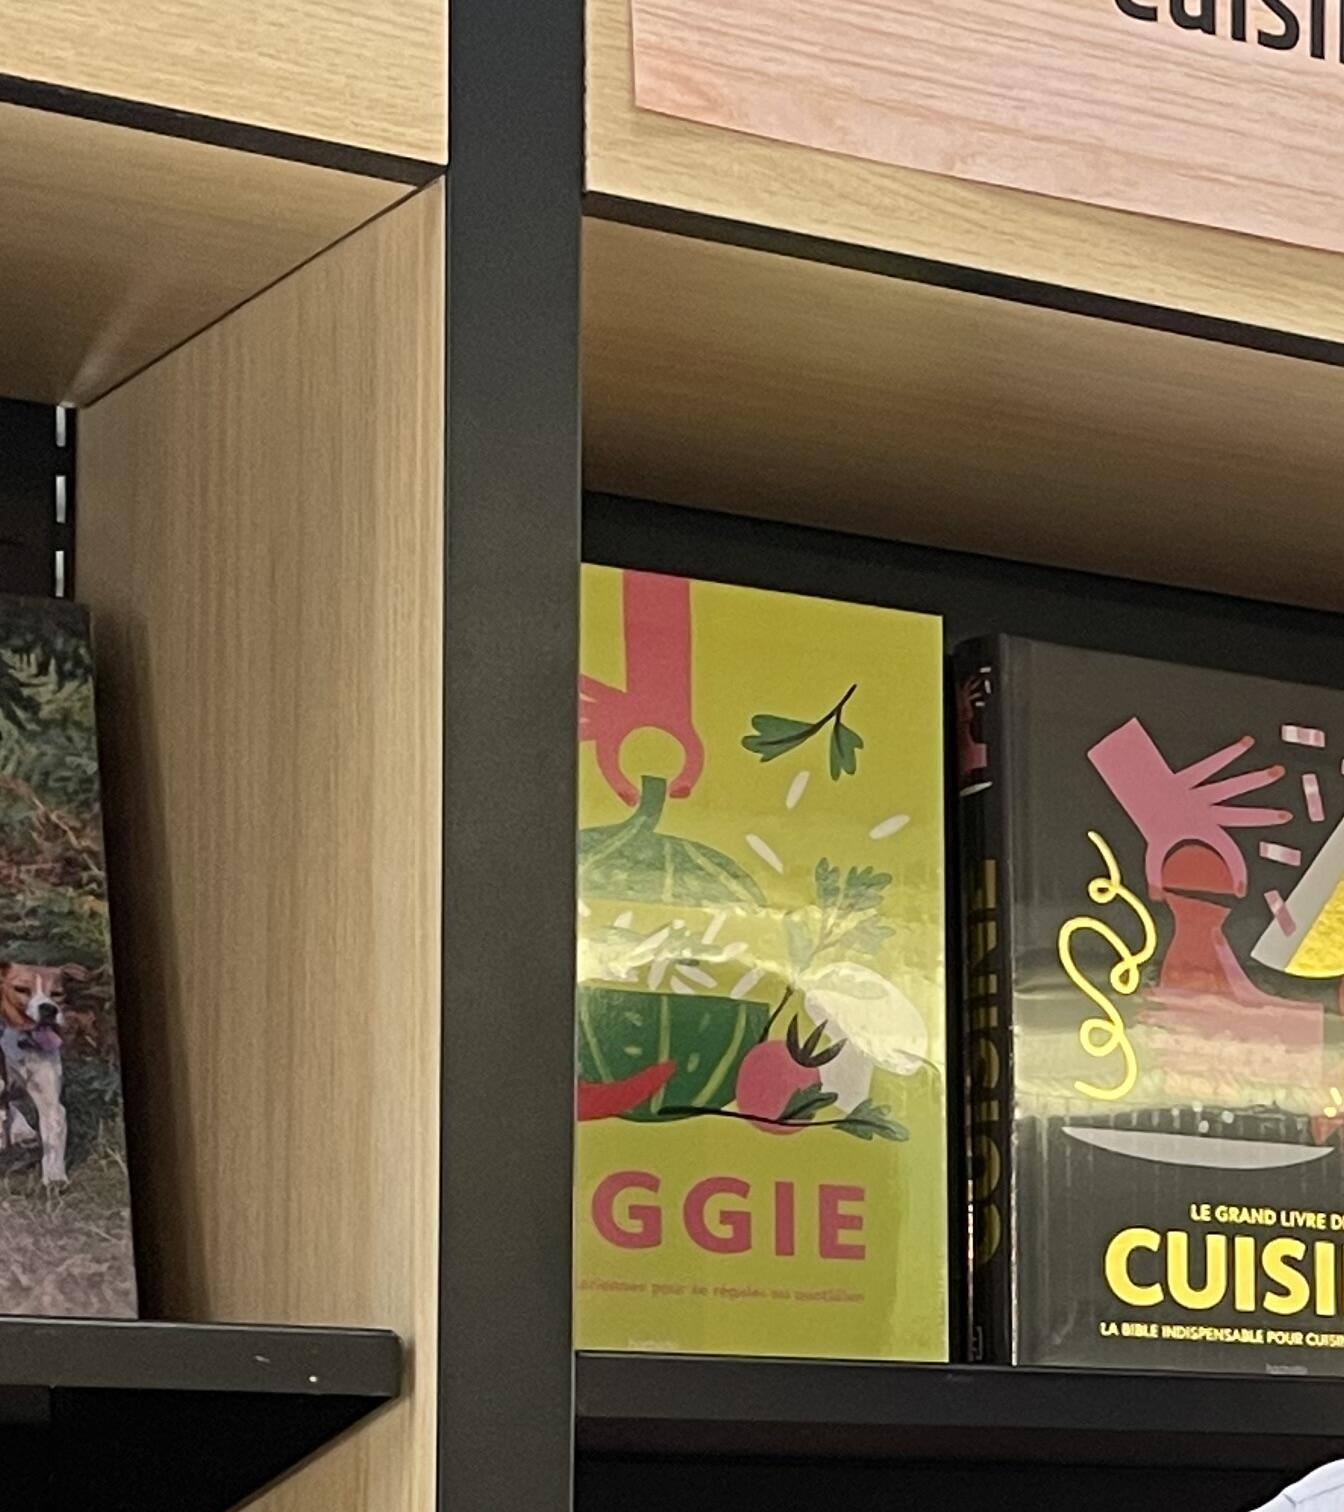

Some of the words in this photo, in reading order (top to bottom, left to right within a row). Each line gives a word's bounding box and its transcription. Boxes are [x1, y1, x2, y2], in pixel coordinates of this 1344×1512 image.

[591, 1169, 866, 1261] GGIE
[1190, 1203, 1211, 1222] LE
[1215, 1205, 1277, 1226] GRAND
[1280, 1210, 1327, 1230] LIVRE
[1100, 1321, 1119, 1337] LA
[1121, 1322, 1159, 1339] BIBLE
[1161, 1325, 1265, 1345] INDISPENSABLE
[1266, 1330, 1304, 1346] POUR
